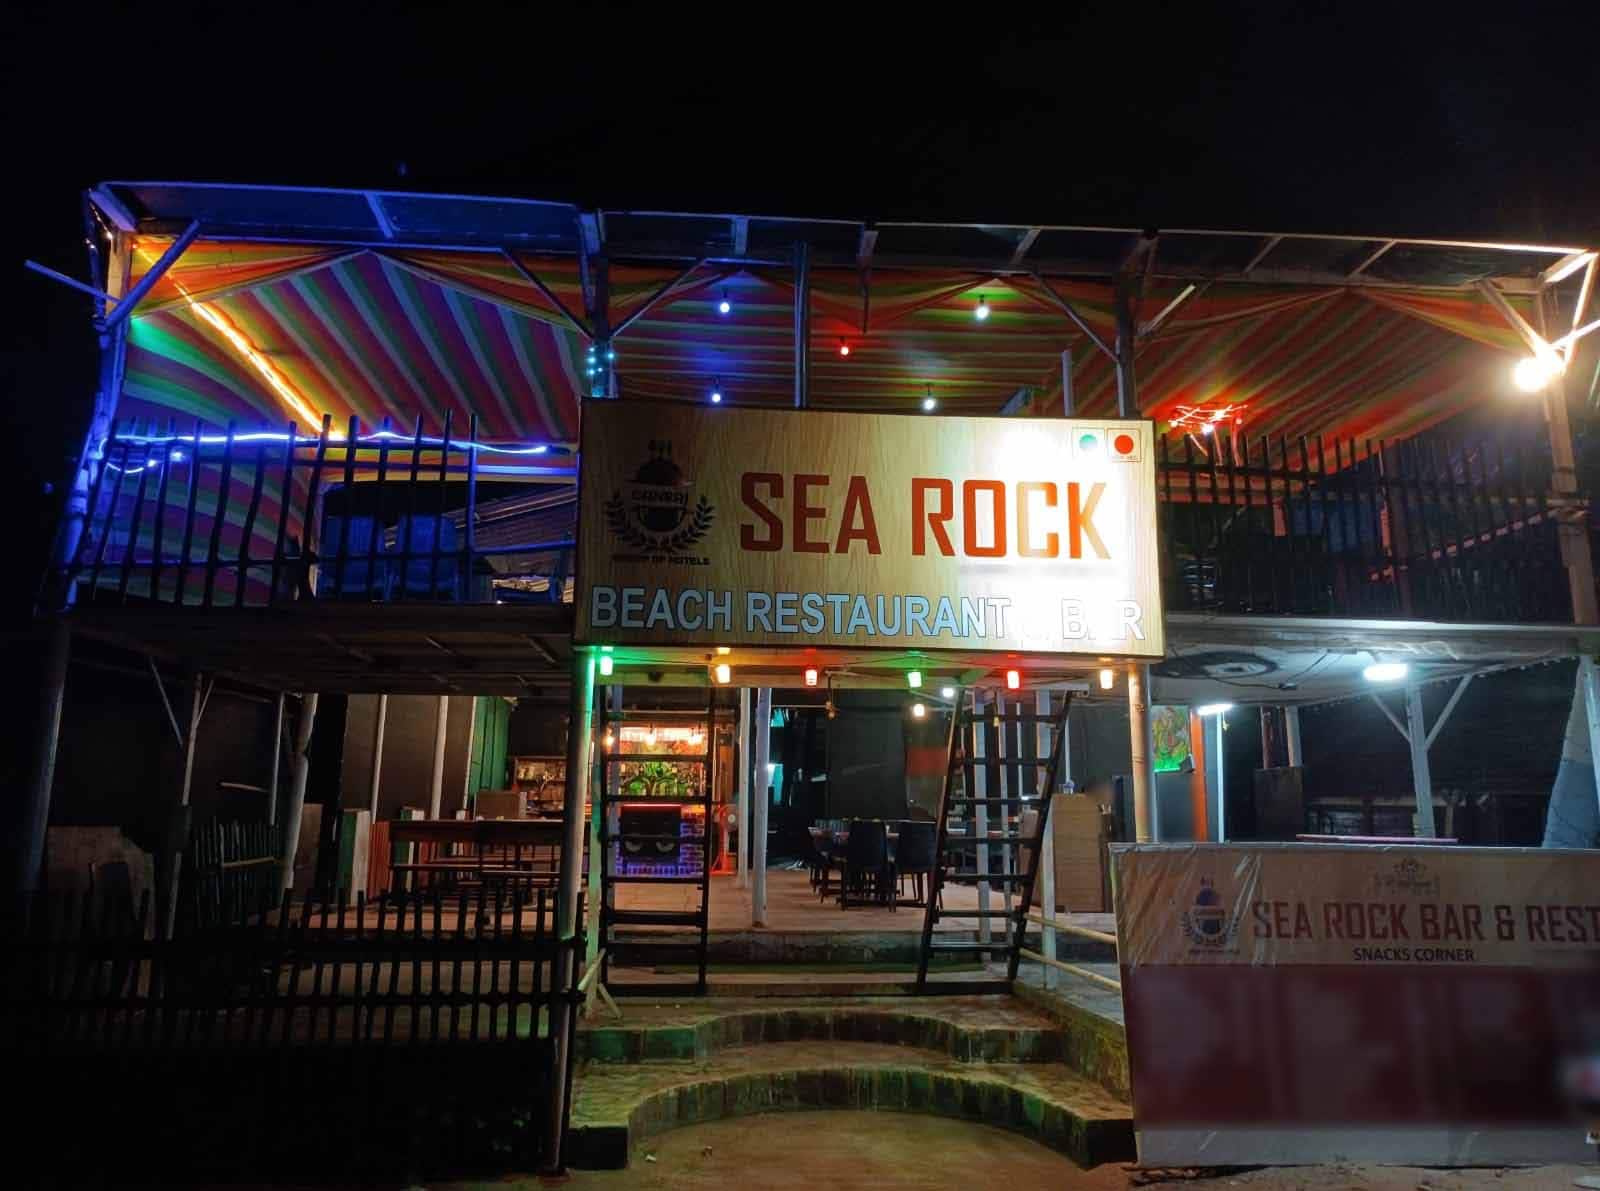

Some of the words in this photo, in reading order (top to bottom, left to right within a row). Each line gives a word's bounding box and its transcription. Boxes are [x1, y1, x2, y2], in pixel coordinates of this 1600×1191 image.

[740, 472, 881, 555] SEA
[912, 478, 1111, 559] ROCK
[591, 585, 732, 632] BEACH
[746, 592, 1012, 639] RESTAURANT
[1062, 599, 1145, 640] BR
[1252, 902, 1313, 939] SEA
[1324, 902, 1409, 940] ROCK
[1420, 903, 1487, 941] BAR
[1494, 904, 1515, 942] &
[1353, 948, 1410, 962] SNACKS
[1414, 948, 1475, 962] CORNER
